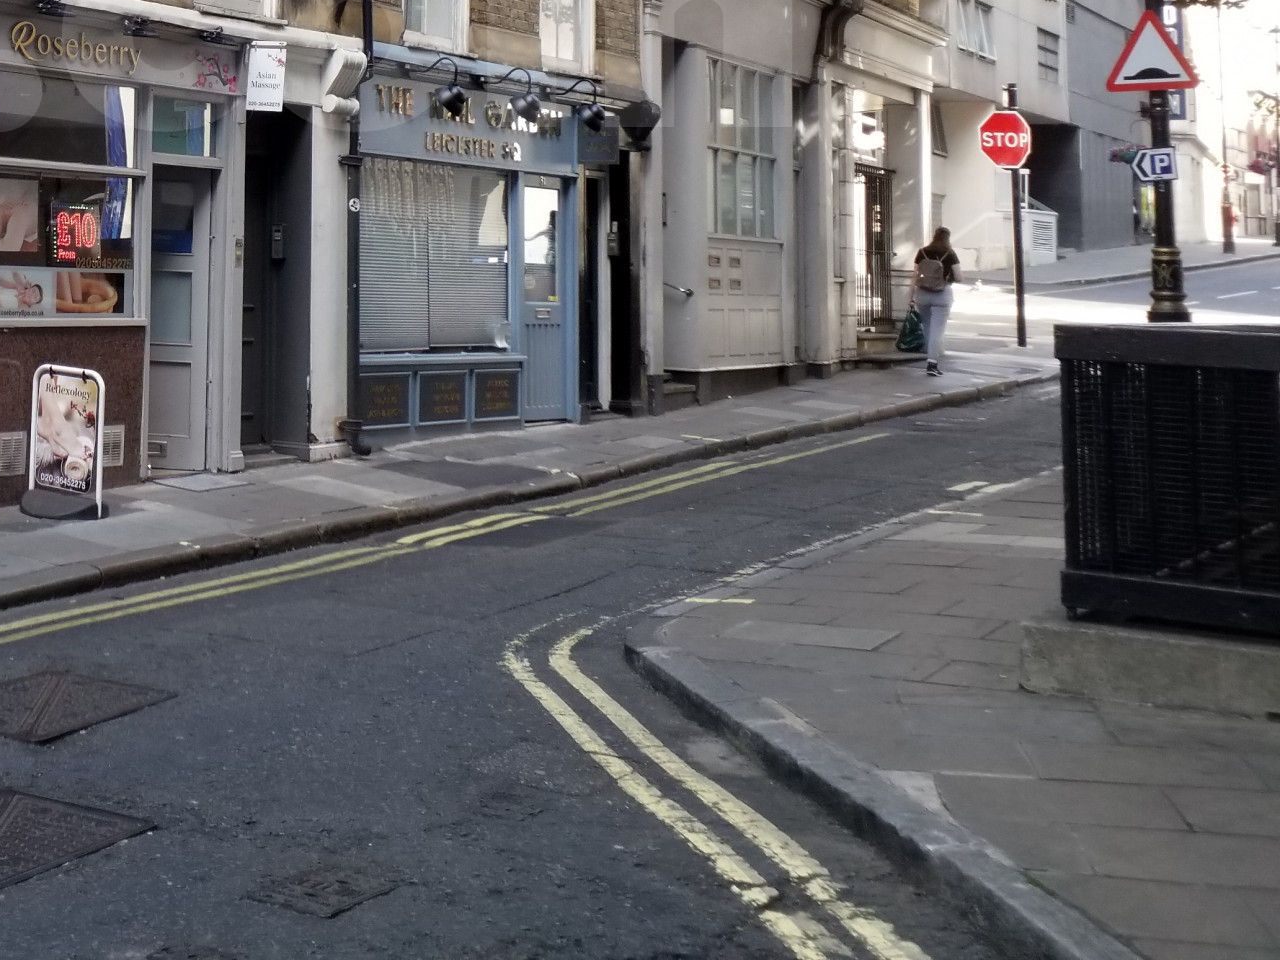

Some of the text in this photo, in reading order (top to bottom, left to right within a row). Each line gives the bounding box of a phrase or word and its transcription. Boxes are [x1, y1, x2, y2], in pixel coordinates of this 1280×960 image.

[9, 20, 142, 75] Roseberry
[257, 71, 277, 80] Asian
[250, 80, 281, 90] Massage
[375, 84, 415, 117] THE
[425, 132, 522, 162] LEICESTER SQ
[982, 131, 1029, 148] STOP
[1155, 155, 1169, 174] P
[56, 211, 97, 248] £10
[57, 248, 76, 259] From
[45, 383, 92, 401] Reflexology
